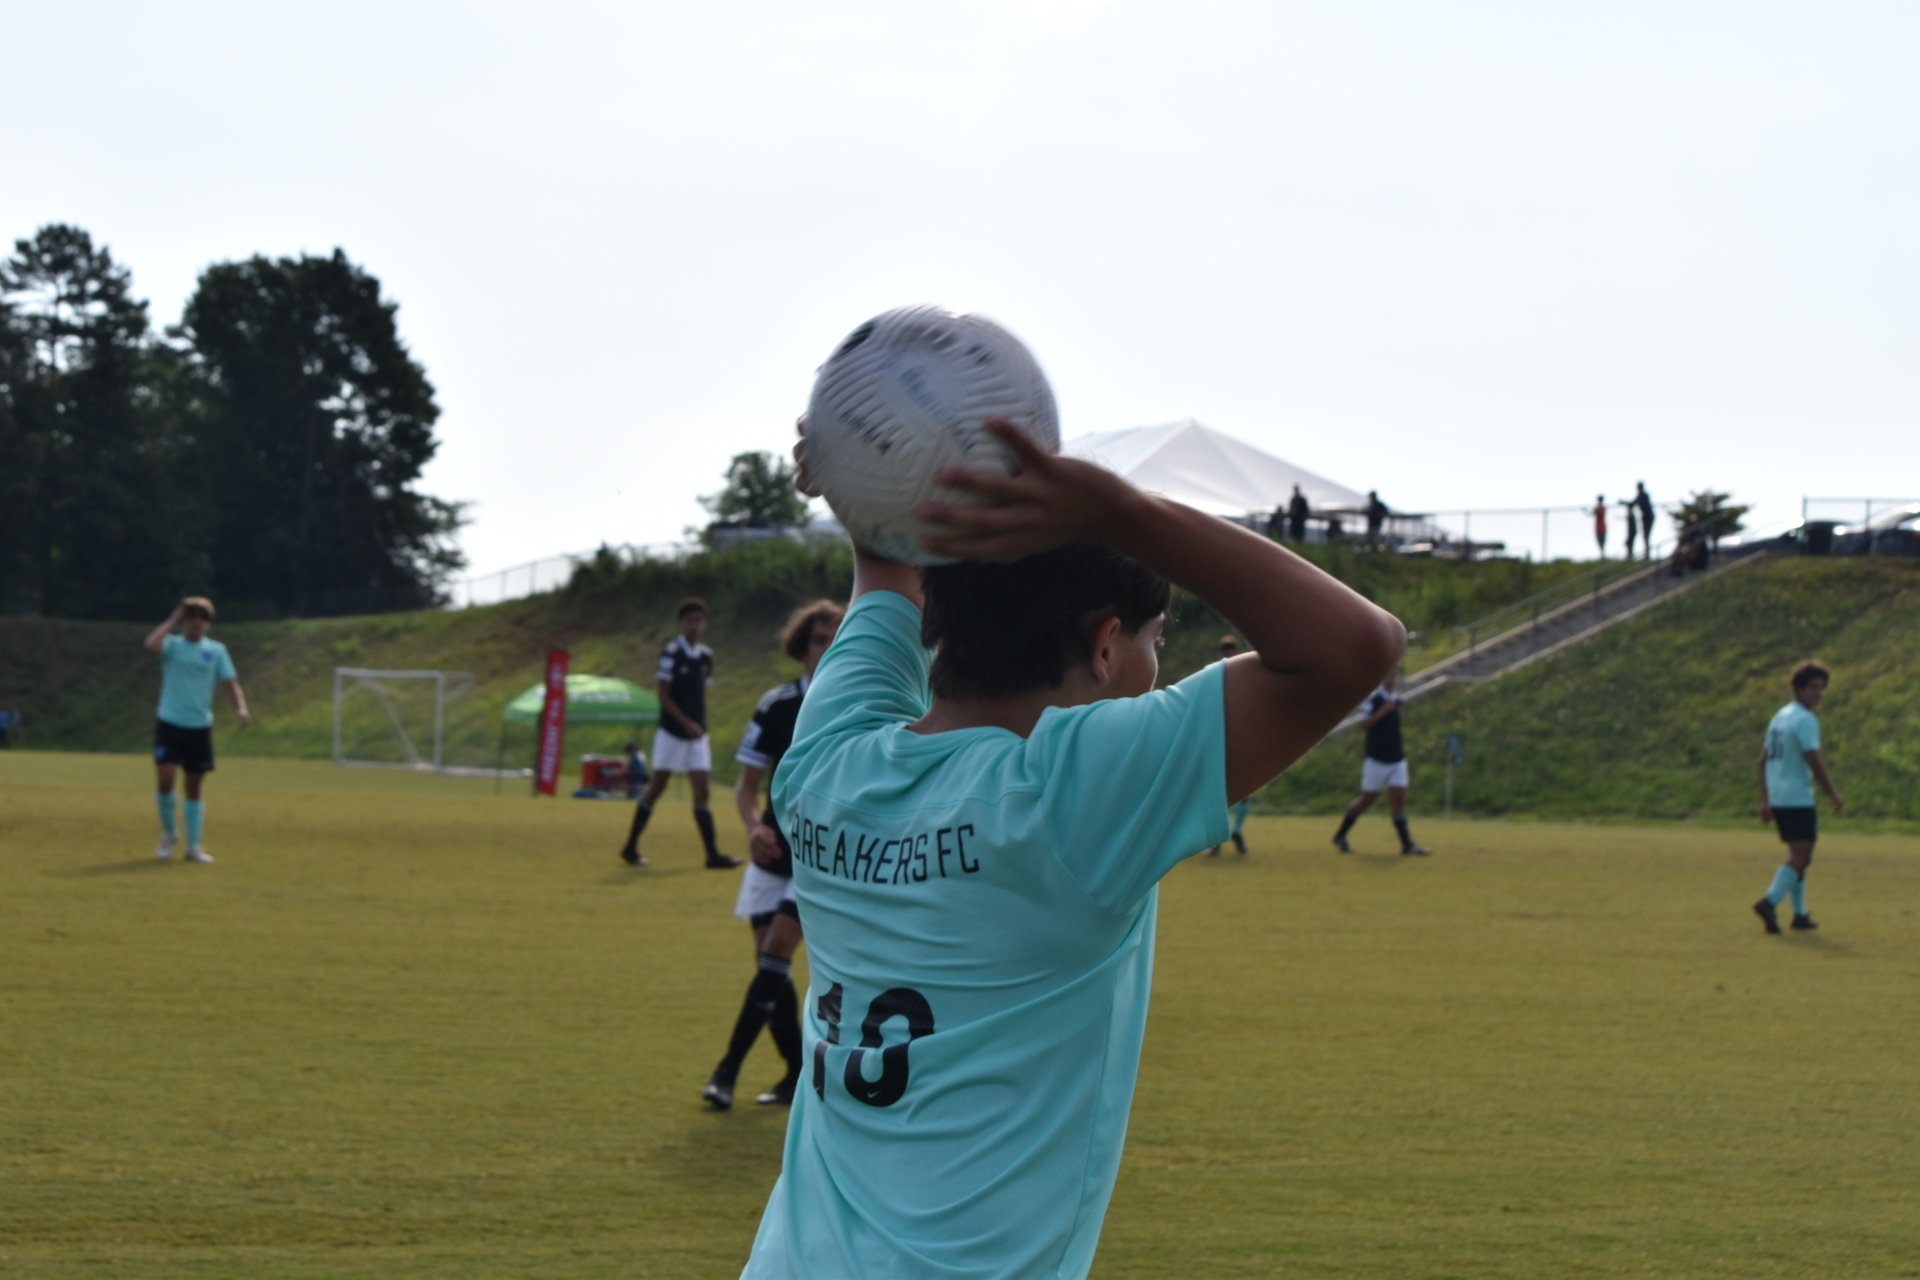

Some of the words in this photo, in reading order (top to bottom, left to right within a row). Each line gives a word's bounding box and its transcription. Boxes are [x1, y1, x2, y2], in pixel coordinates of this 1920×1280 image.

[792, 812, 928, 885] BREAKERS
[936, 823, 981, 878] FC
[813, 981, 935, 1108] 10
